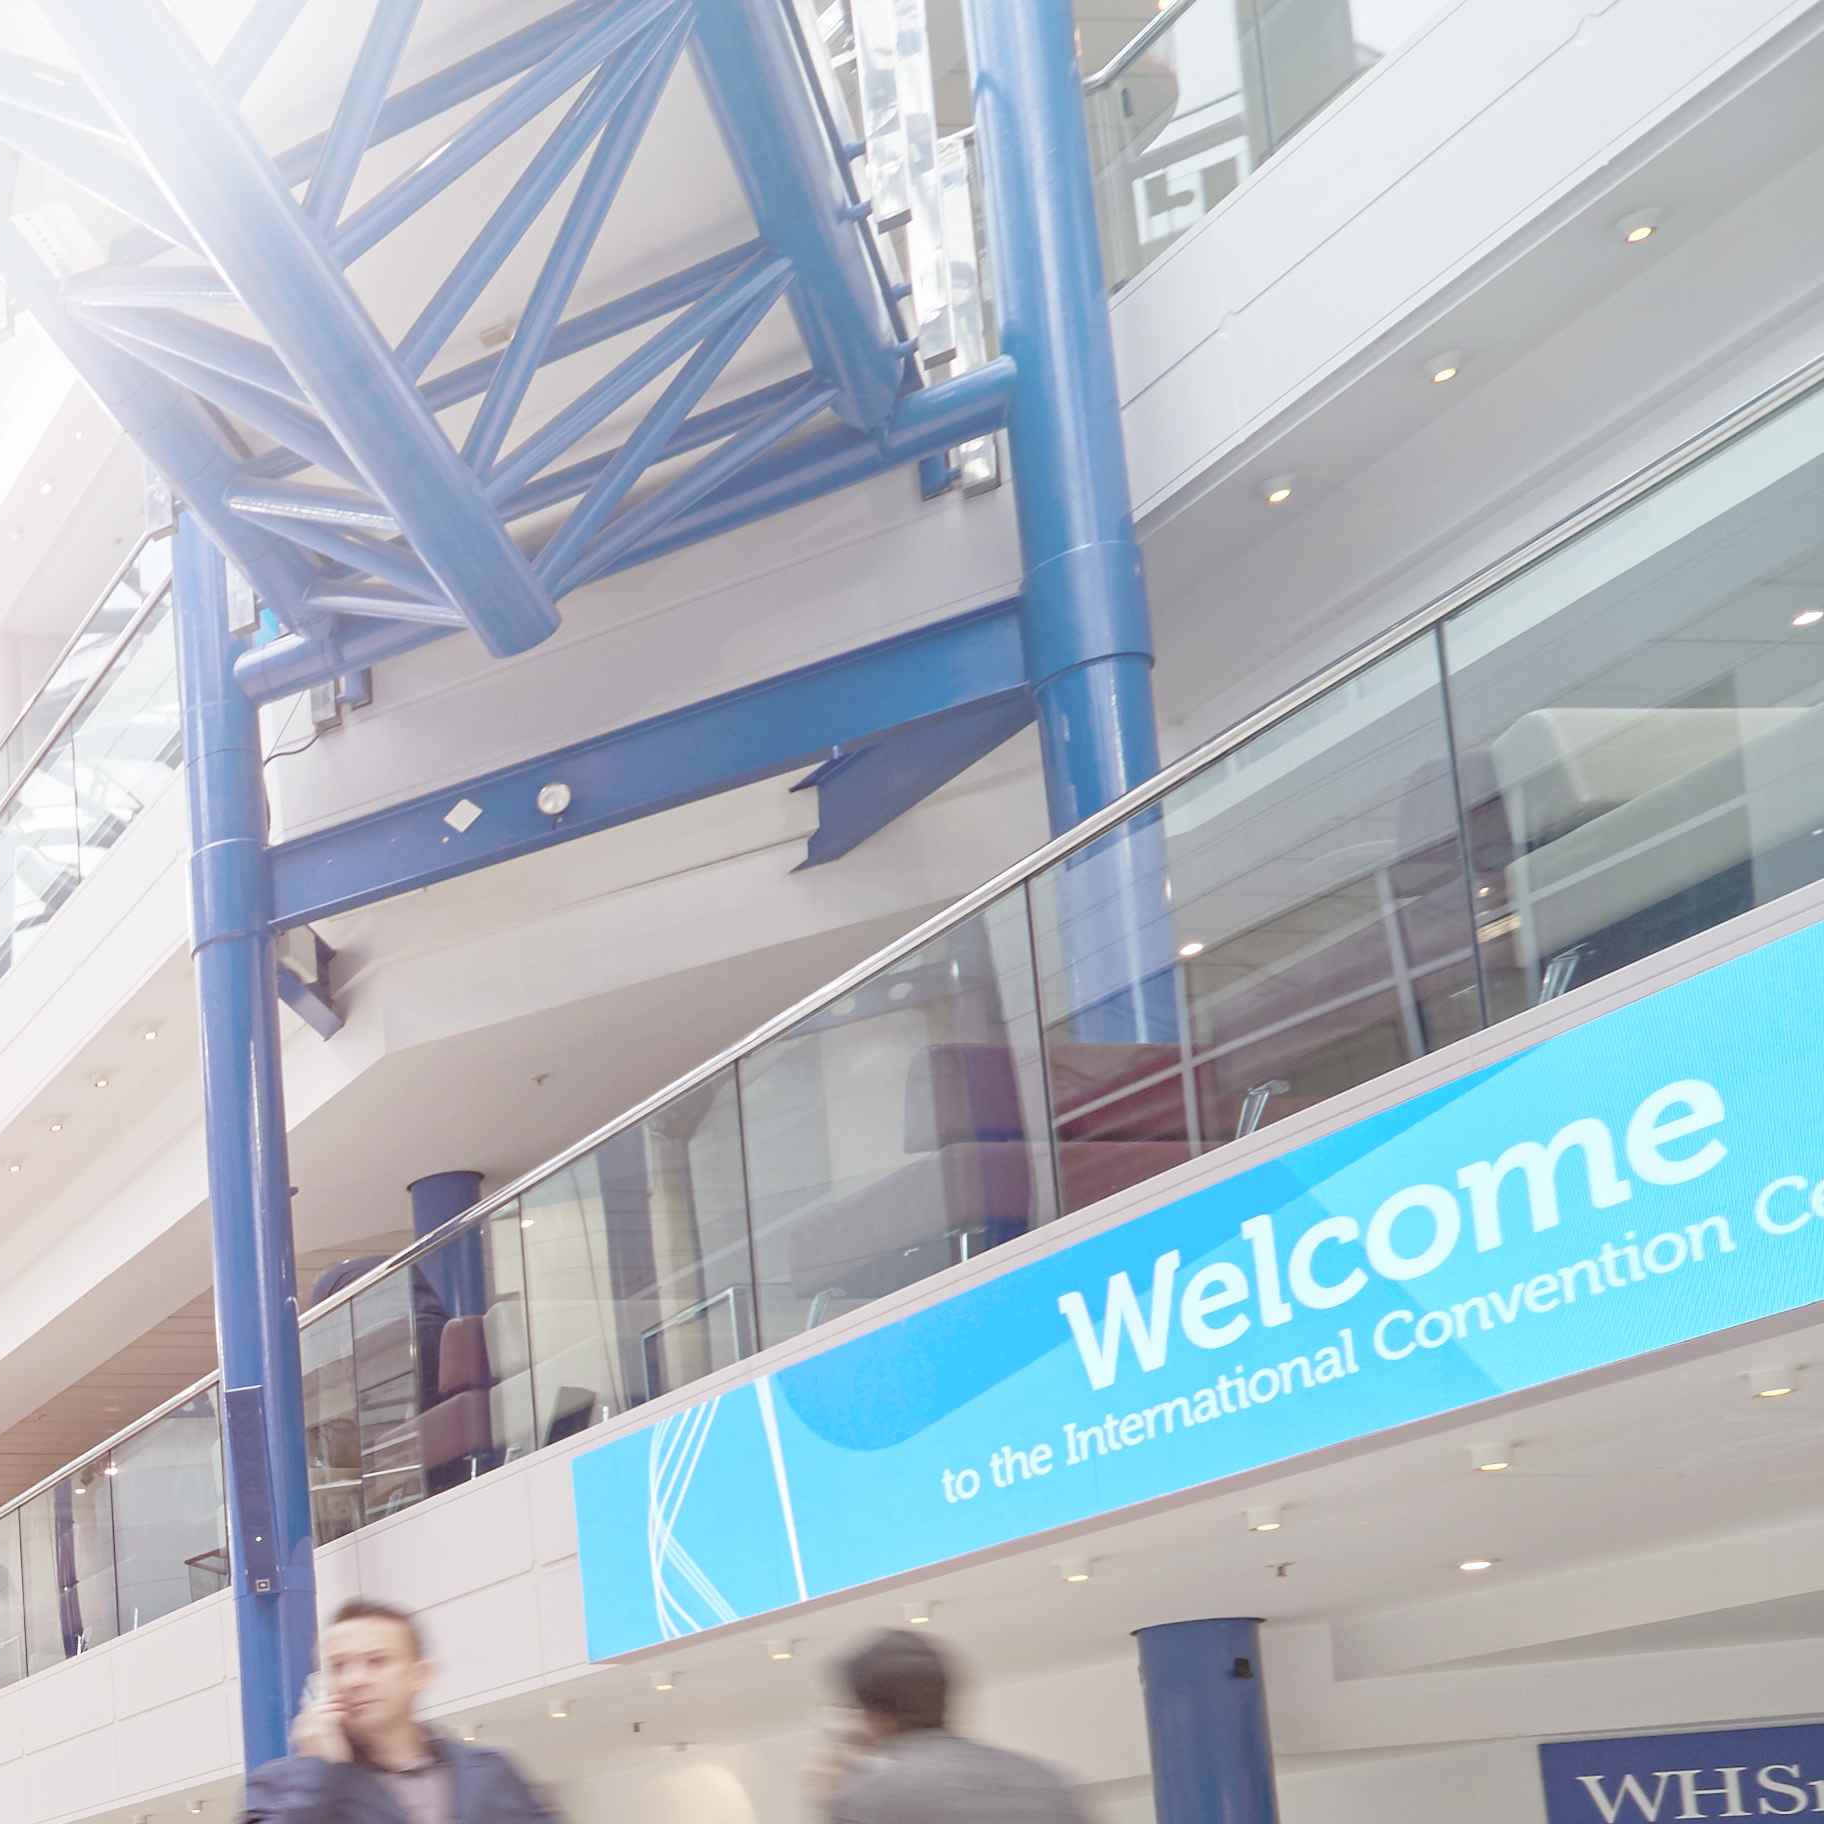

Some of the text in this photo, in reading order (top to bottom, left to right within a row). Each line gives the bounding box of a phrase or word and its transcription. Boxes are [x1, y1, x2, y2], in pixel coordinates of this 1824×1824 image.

[940, 1467, 981, 1503] to
[989, 1434, 1054, 1490] the
[1064, 1328, 1359, 1467] International
[1373, 1215, 1736, 1362] Convention
[1058, 1078, 1727, 1392] Welcome
[1574, 1763, 1824, 1824] WHS
